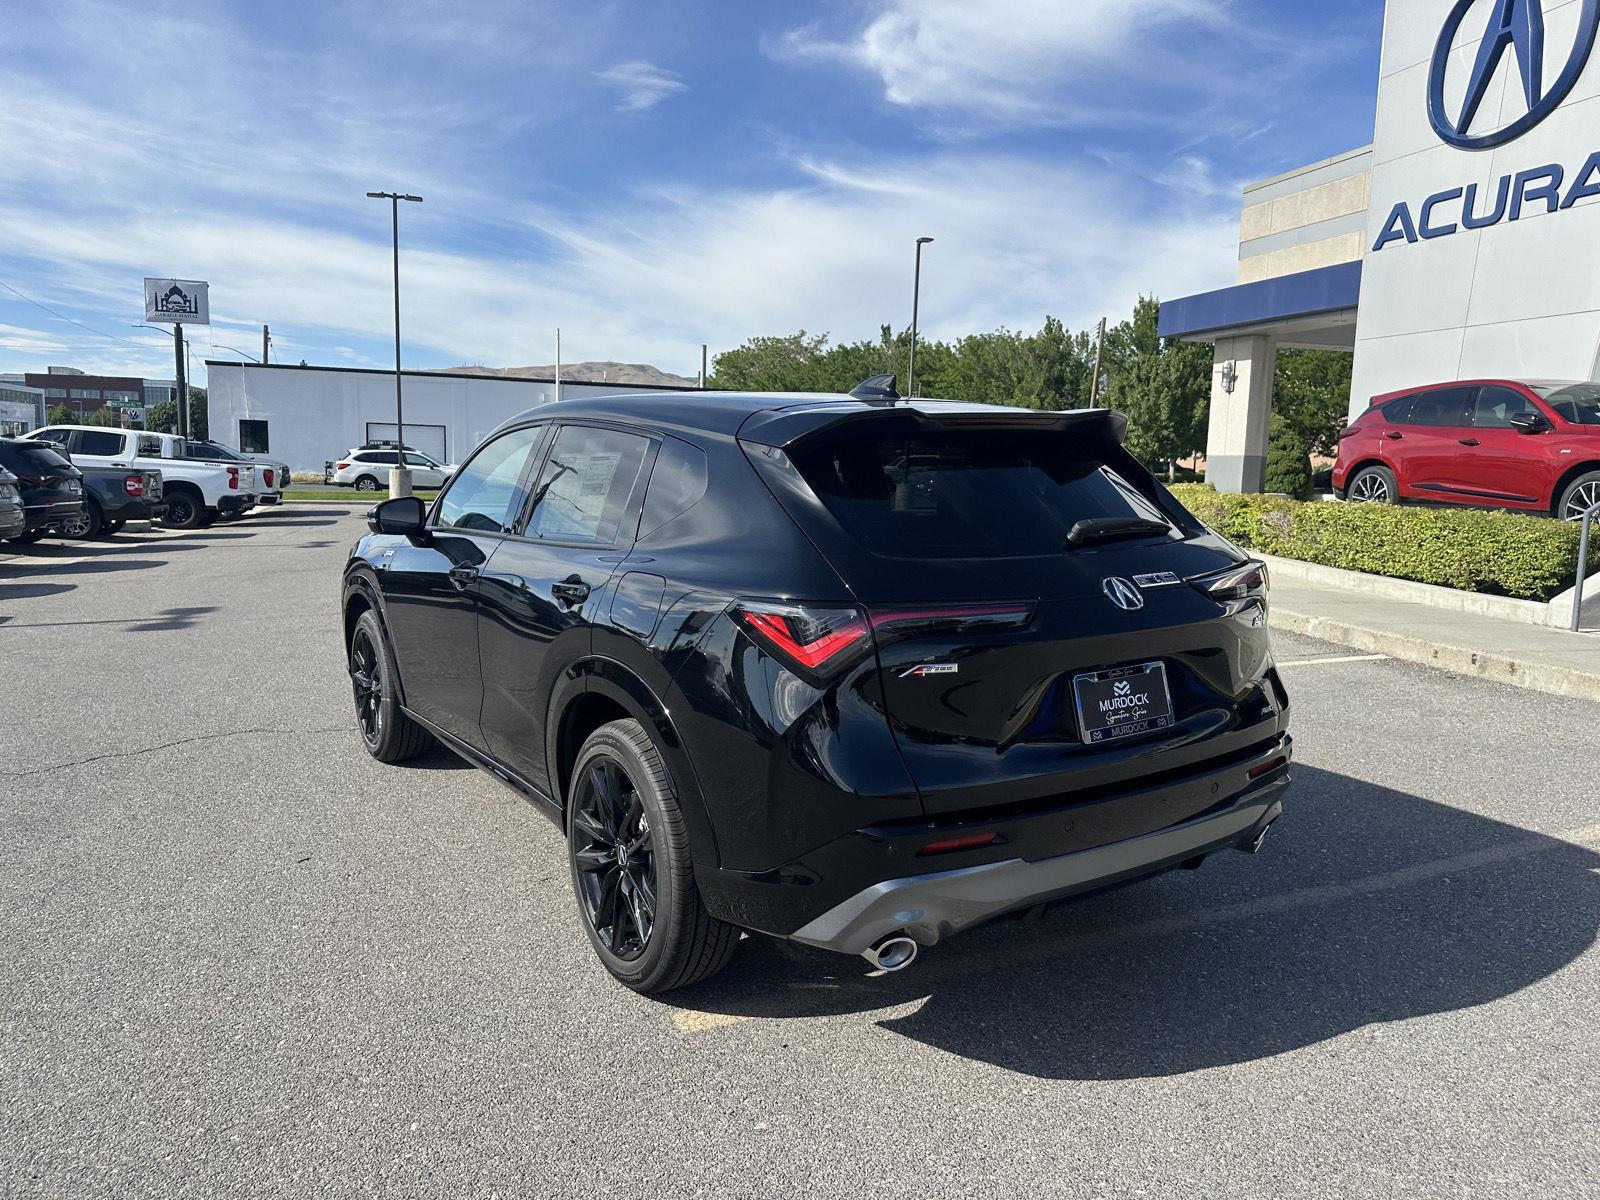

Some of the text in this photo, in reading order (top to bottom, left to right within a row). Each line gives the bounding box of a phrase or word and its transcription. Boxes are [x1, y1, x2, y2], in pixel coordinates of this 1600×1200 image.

[1372, 151, 1600, 251] ACURA
[1099, 692, 1150, 712] MURDOCK
[1111, 720, 1150, 737] MURDOCK
